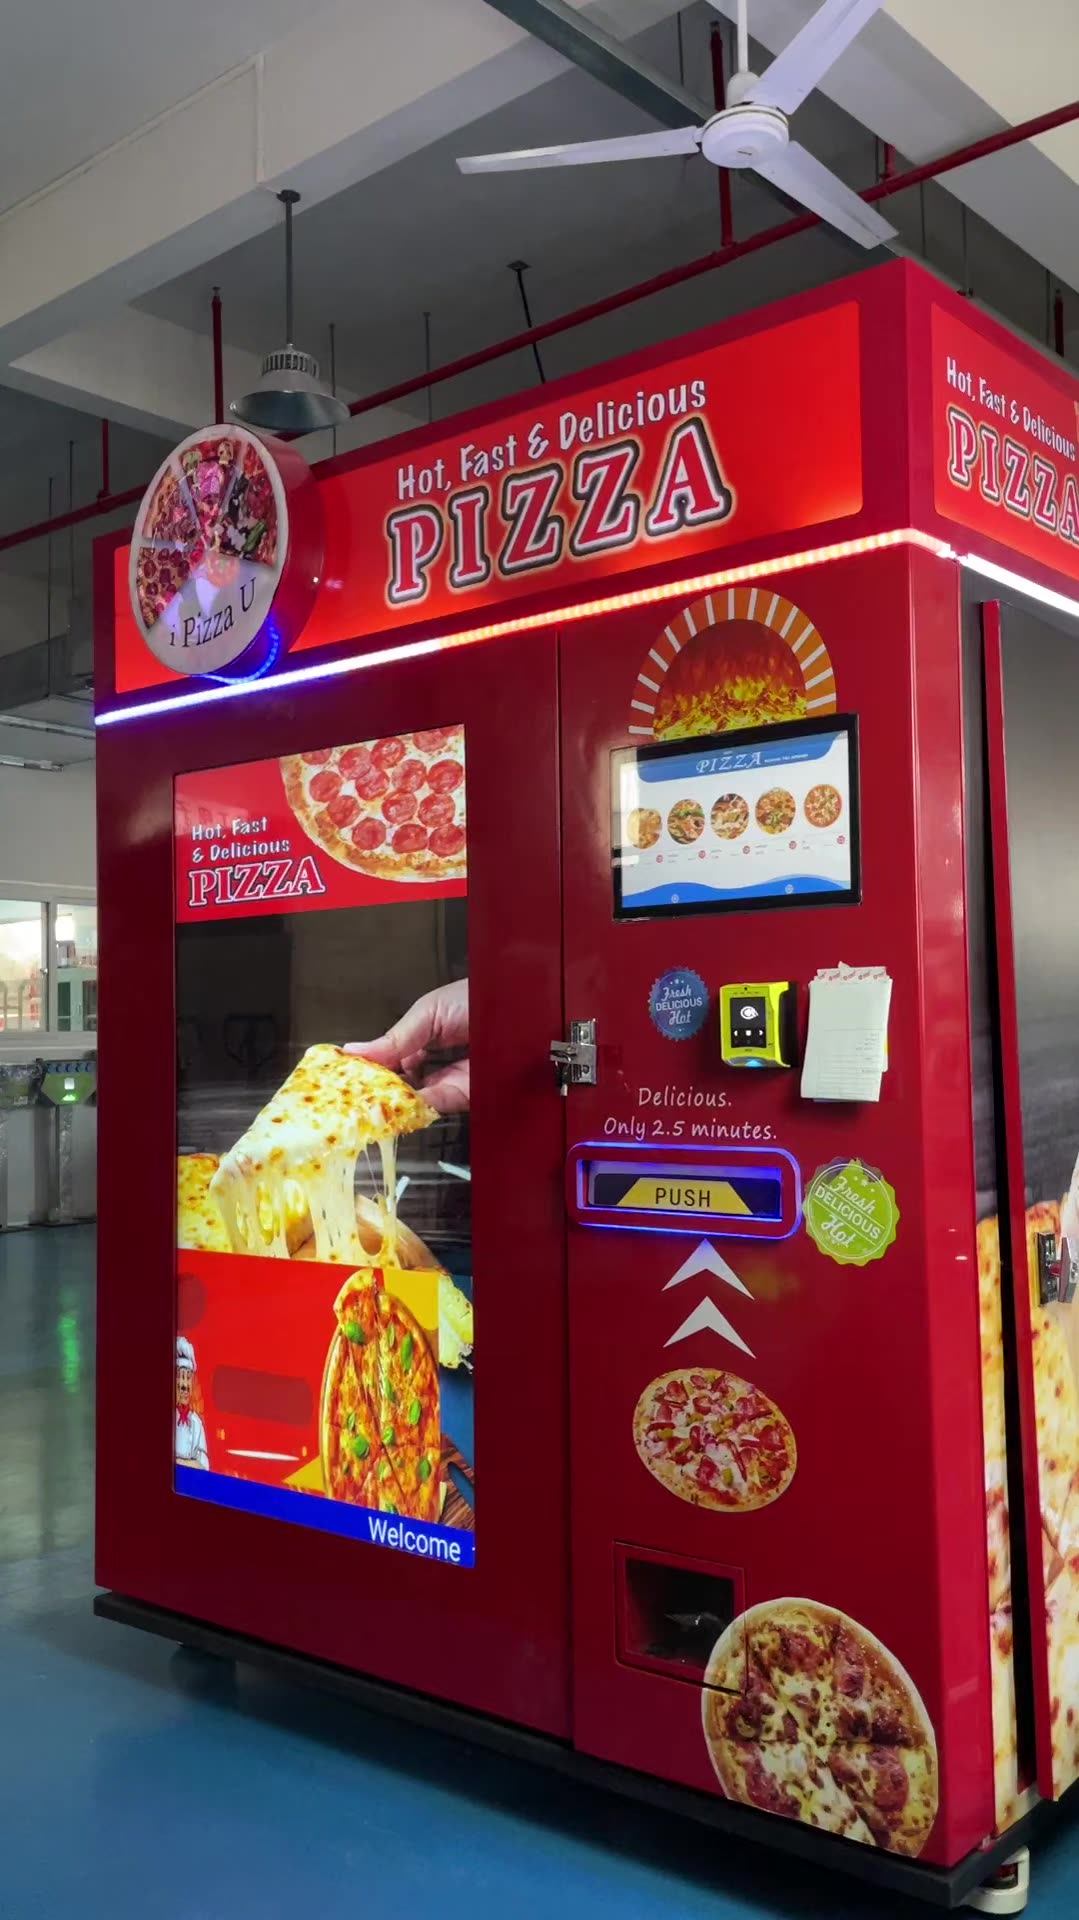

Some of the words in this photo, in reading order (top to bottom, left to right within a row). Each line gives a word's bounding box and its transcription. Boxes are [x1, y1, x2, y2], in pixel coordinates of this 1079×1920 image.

[947, 356, 976, 401] Hot,
[979, 377, 1006, 418] Fast
[1010, 400, 1019, 424] &
[1023, 406, 1075, 461] Delicious
[398, 459, 451, 499] Hot,
[460, 435, 518, 480] Fast
[527, 422, 549, 459] &
[559, 380, 706, 450] Delicious
[388, 418, 731, 603] PIZZA
[182, 605, 234, 648] Pizza
[240, 577, 256, 612] U
[696, 752, 760, 773] PIZZA
[192, 823, 226, 841] Hot,
[232, 817, 268, 836] Fast
[192, 847, 204, 863] &
[210, 839, 290, 861] Delicious
[188, 855, 326, 907] PIZZA
[655, 997, 703, 1011] DELICIOUS
[661, 984, 692, 1002] Fresh
[669, 1010, 692, 1025] Hot
[638, 1086, 732, 1107] Delicious.
[604, 1116, 645, 1142] Only
[652, 1120, 685, 1137] 2.5
[692, 1118, 777, 1140] minutes.
[655, 1187, 711, 1208] PUSH
[830, 1176, 876, 1215] Fresh
[815, 1185, 881, 1239] DELICIOUS
[821, 1213, 856, 1248] Hot
[368, 1516, 461, 1562] Welcome
